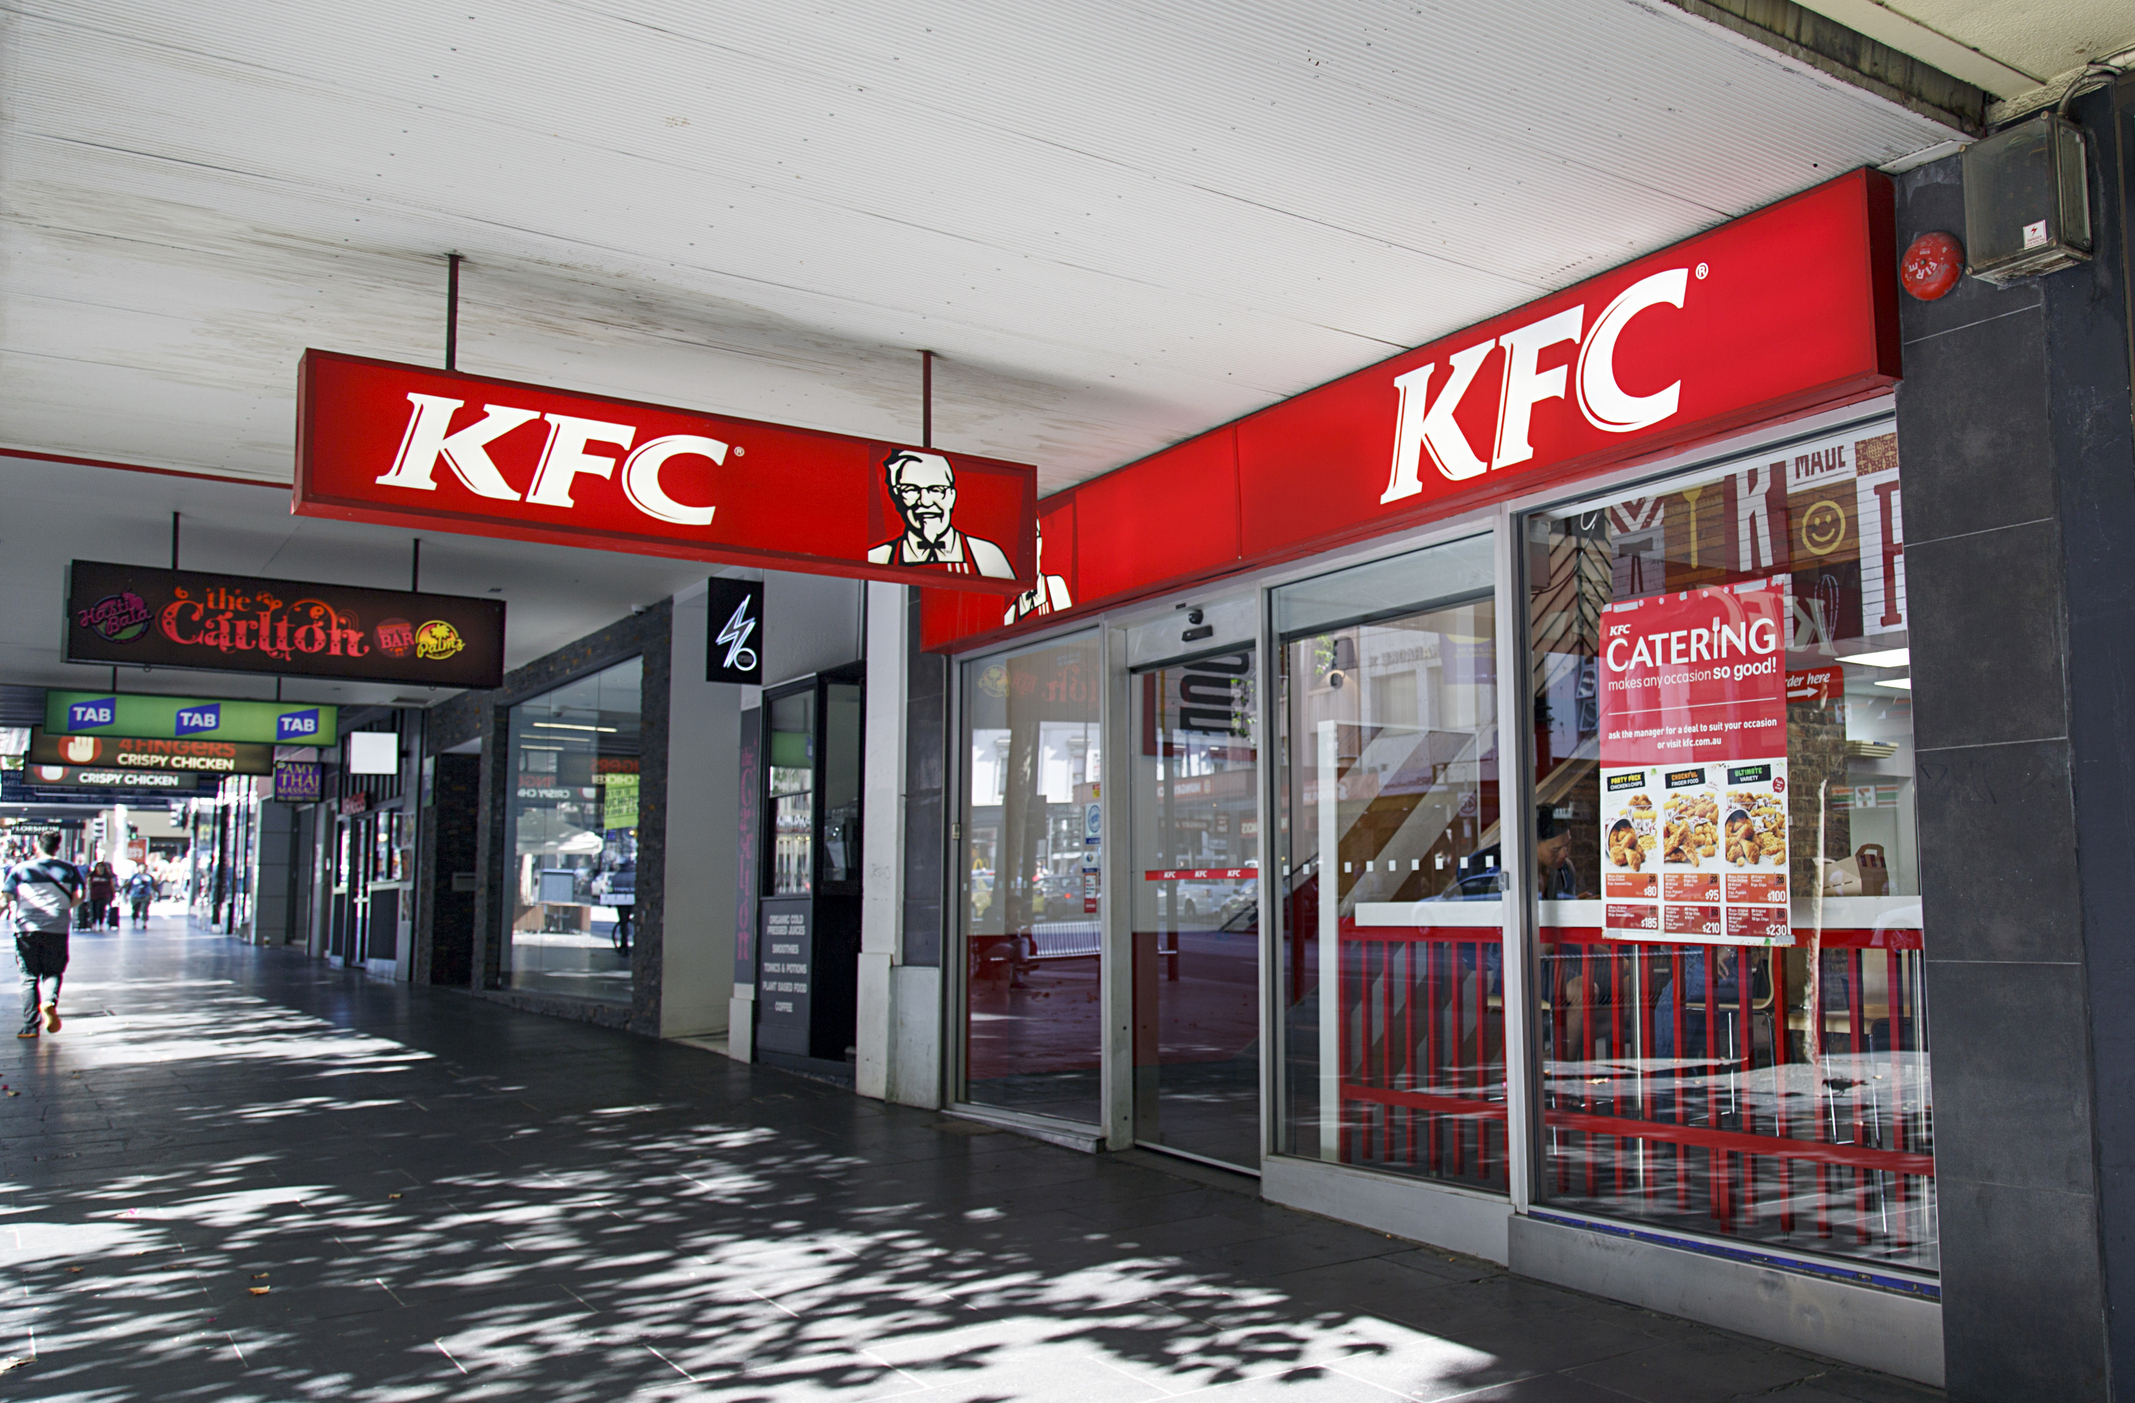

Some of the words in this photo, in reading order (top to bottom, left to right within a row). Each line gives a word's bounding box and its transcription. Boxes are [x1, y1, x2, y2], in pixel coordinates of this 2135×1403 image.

[1908, 261, 1938, 280] FIRE
[206, 587, 251, 612] the
[78, 597, 135, 628] Hasti
[105, 608, 152, 636] Bala
[156, 588, 370, 661] Carlton
[1609, 624, 1631, 637] KFC
[379, 632, 415, 649] BAR
[1606, 617, 1776, 673] CATERING
[1608, 676, 1642, 691] makes
[1643, 673, 1662, 689] any
[1664, 668, 1711, 685] occasion
[1713, 665, 1730, 680] so
[1733, 657, 1777, 681] good!
[1785, 674, 1804, 688] rder
[1806, 671, 1831, 685] here
[72, 706, 112, 723] TAB
[180, 711, 217, 728] TAB
[280, 716, 315, 734] TAB
[1608, 730, 1621, 740] ask
[1621, 729, 1633, 739] the
[1634, 727, 1664, 739] manager
[1665, 725, 1677, 735] for
[1677, 726, 1683, 734] a
[1683, 723, 1698, 733] deal
[1700, 723, 1708, 732] to
[1709, 721, 1723, 732] suit
[1724, 721, 1742, 733] your
[1743, 718, 1777, 729] occasion
[118, 739, 133, 752] 4
[1657, 741, 1665, 749] or
[1666, 738, 1682, 748] visit
[1682, 736, 1722, 748] kfc.com.au
[117, 753, 169, 768] CRISPY
[170, 755, 235, 771] CHICKEN
[284, 763, 315, 775] AMY
[1734, 767, 1763, 777] ULTIMATE
[78, 772, 123, 785] CRISPY
[124, 773, 179, 787] CHICKEN
[280, 774, 320, 788] THAI
[1611, 776, 1628, 785] PARTY
[1628, 774, 1642, 782] PACK
[1687, 777, 1699, 785] FOOD
[1739, 775, 1759, 783] VARIETY
[277, 786, 320, 795] MASSAGE
[1163, 871, 1176, 879] KFC
[1194, 870, 1207, 878] KFC
[1227, 869, 1241, 877] KFC
[1711, 875, 1718, 883] 20
[1643, 885, 1657, 897] $80
[1705, 889, 1719, 901] $95
[1767, 890, 1786, 902] $100
[1640, 917, 1657, 928] $185
[1702, 922, 1720, 934] $210
[1765, 924, 1787, 936] $230
[763, 963, 781, 973] TONICS
[786, 963, 808, 975] POTIONS
[762, 981, 777, 991] PLANT
[777, 982, 793, 992] BASED
[793, 982, 808, 994] FOOD
[775, 1001, 793, 1013] COFFEE
